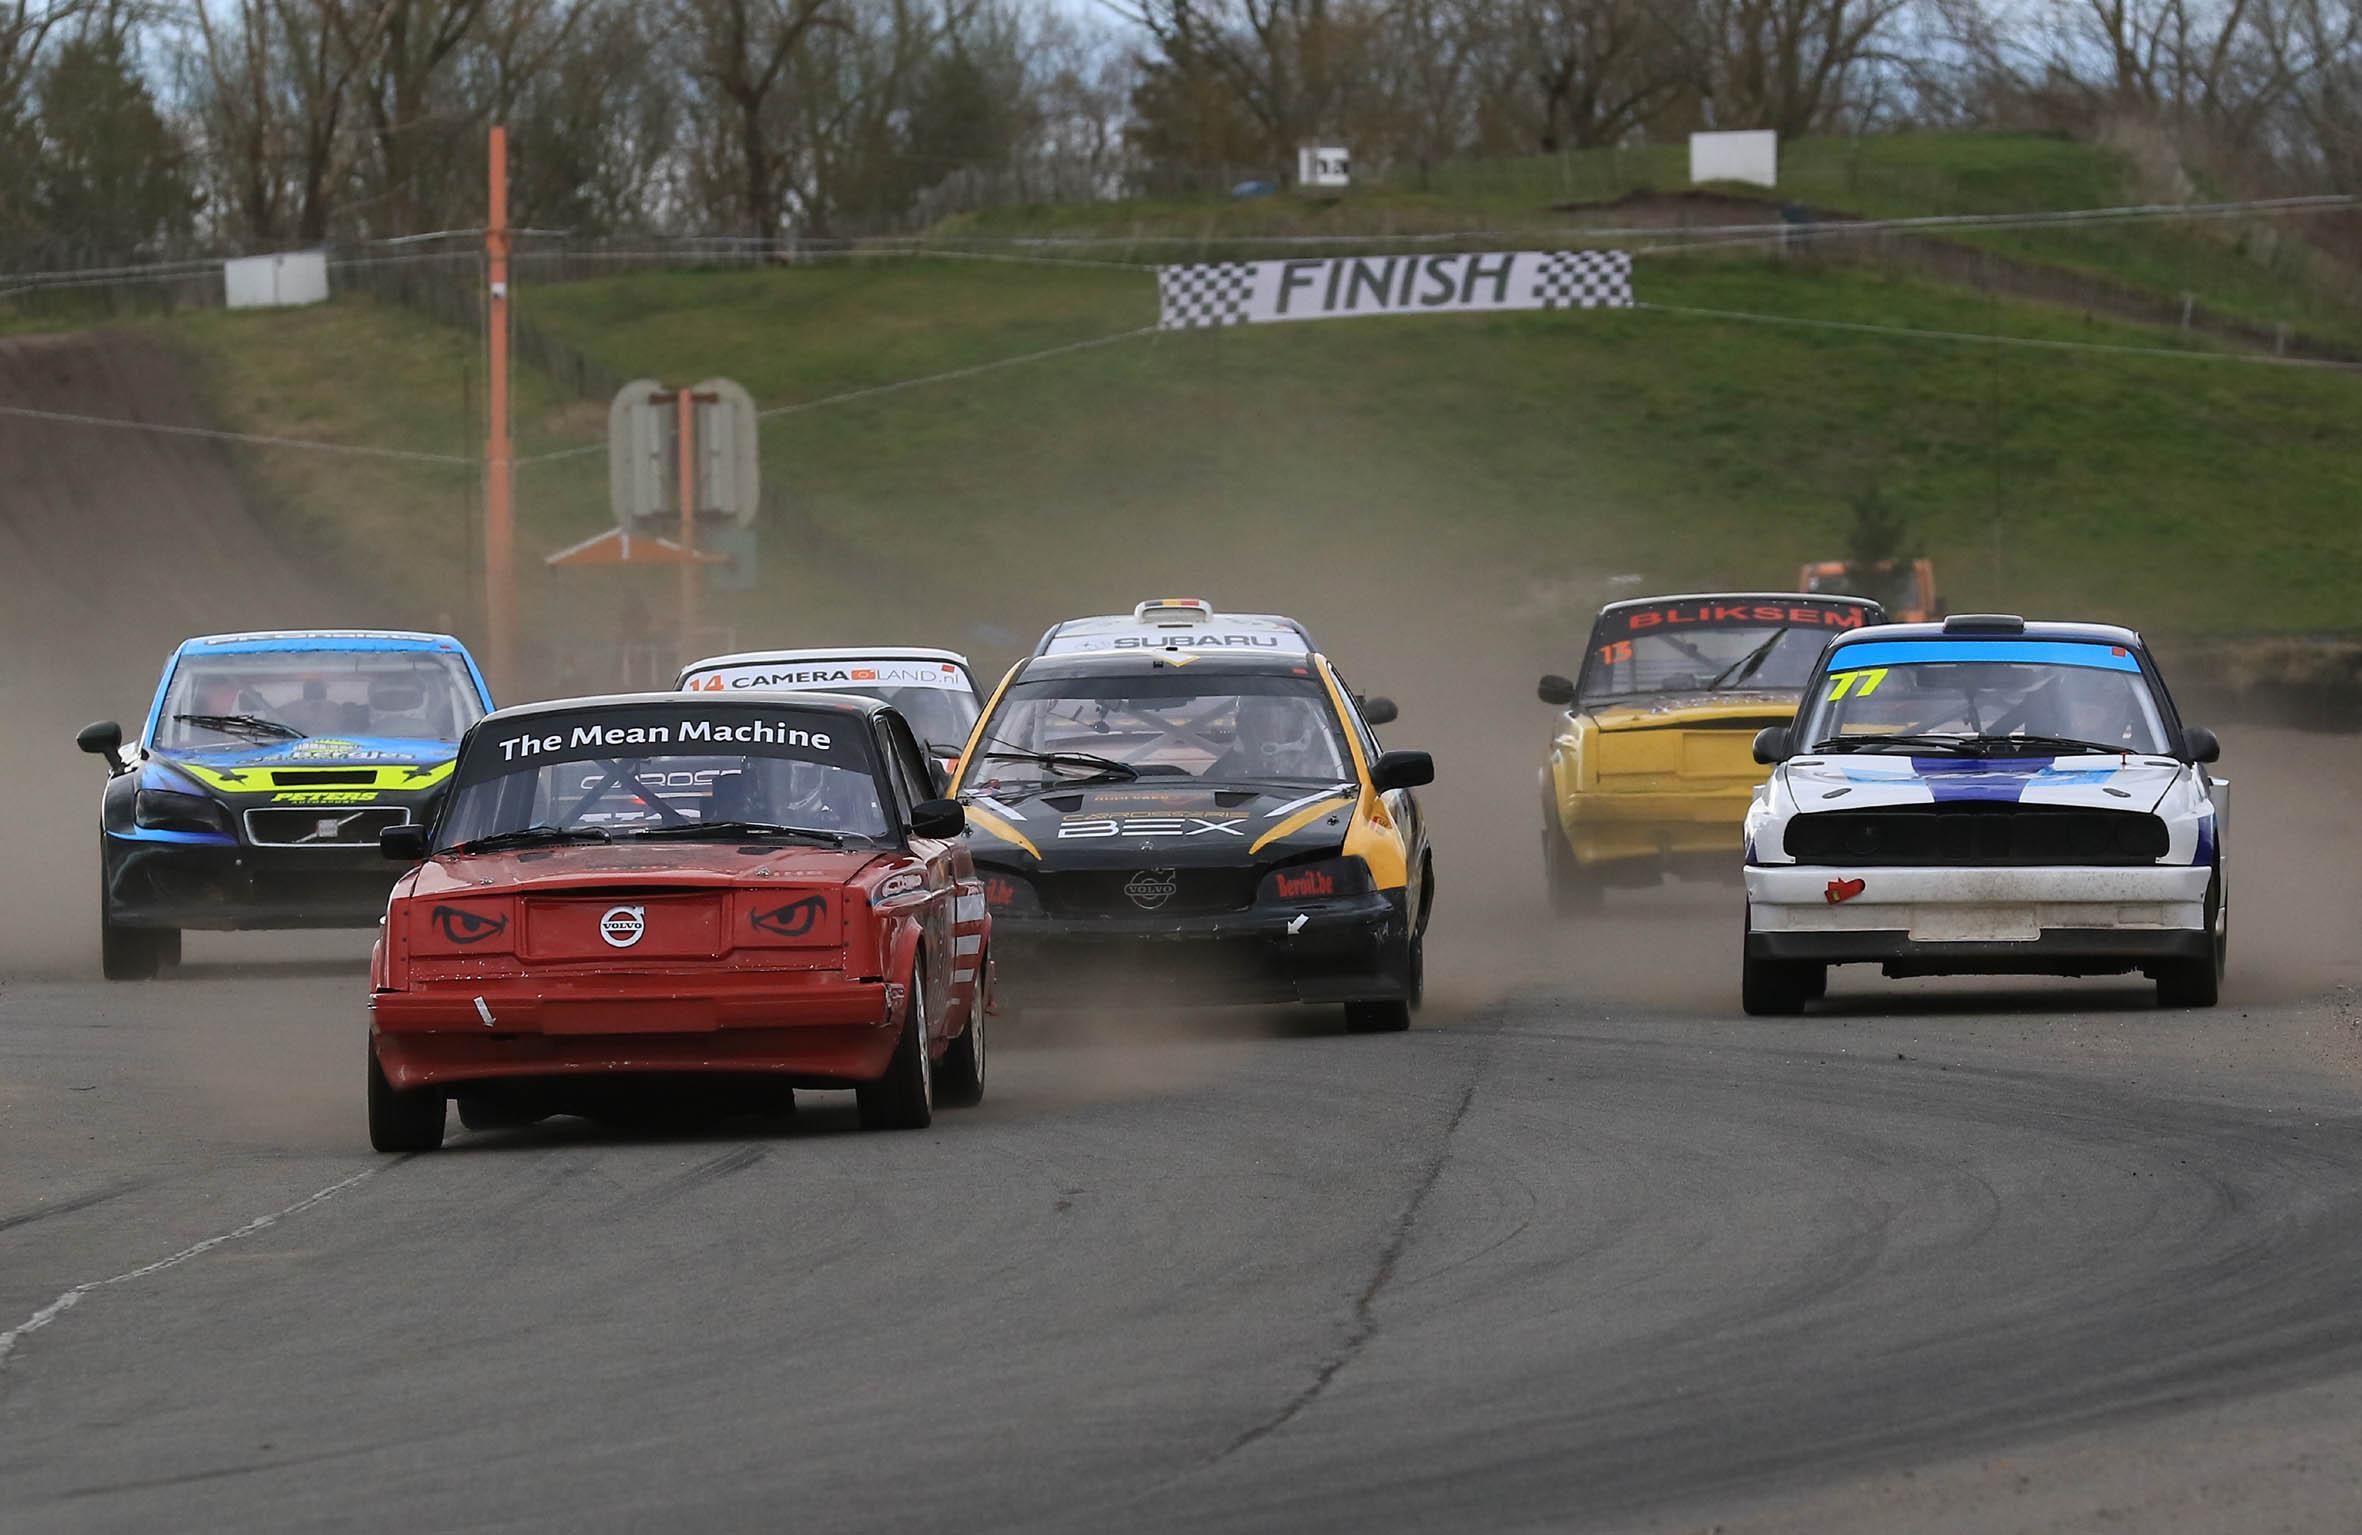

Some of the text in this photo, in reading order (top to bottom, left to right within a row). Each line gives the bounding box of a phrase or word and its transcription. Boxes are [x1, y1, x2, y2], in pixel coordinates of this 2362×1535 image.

[1276, 252, 1515, 313] FINISH
[1629, 607, 1862, 630] BLIKSEM
[1114, 635, 1279, 649] SUBARU
[689, 674, 725, 691] 14
[731, 669, 850, 689] CAMERA
[1828, 668, 1888, 701] 77
[500, 720, 832, 761] The Mean Machine
[271, 791, 379, 802] PETERS
[1058, 818, 1249, 839] BEX
[602, 922, 643, 930] VOLVO
